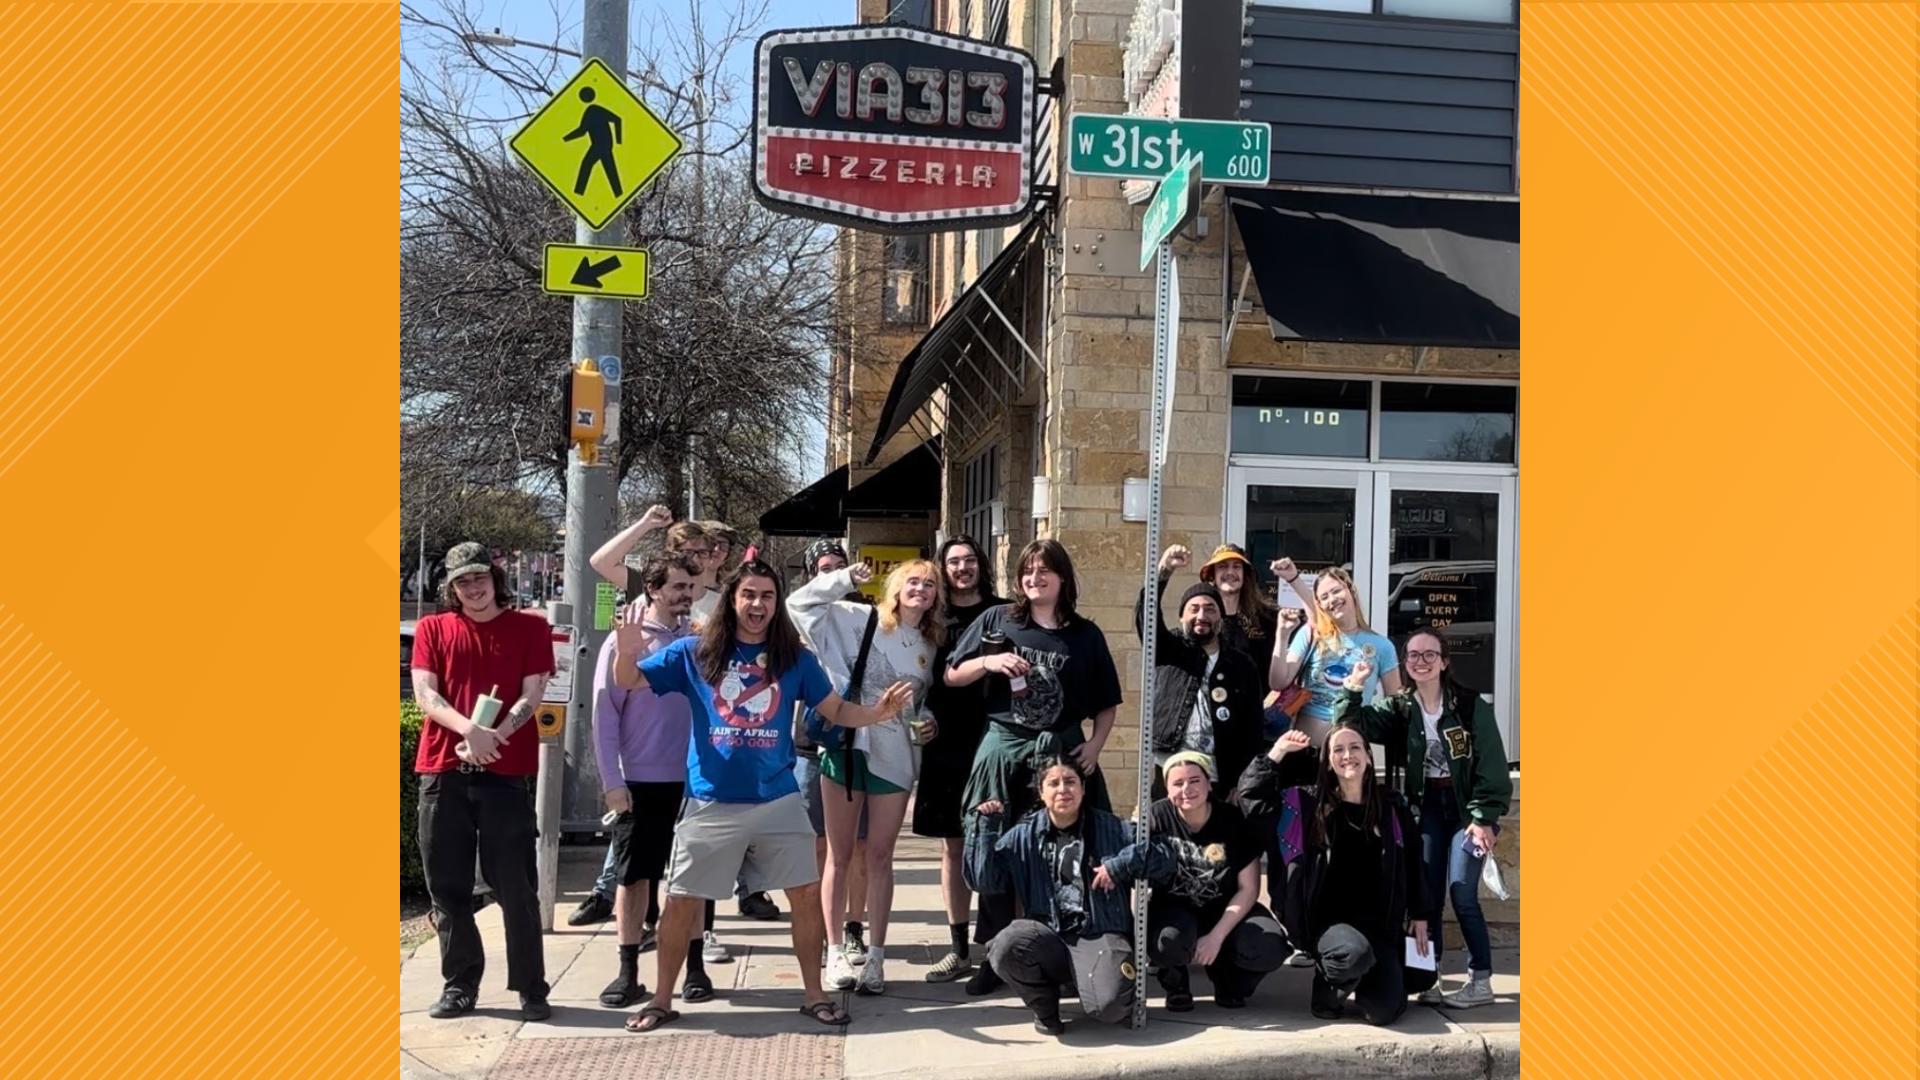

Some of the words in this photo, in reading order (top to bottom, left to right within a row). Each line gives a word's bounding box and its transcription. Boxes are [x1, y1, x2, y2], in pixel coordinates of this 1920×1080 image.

[1078, 132, 1095, 155] W
[1102, 123, 1183, 170] 31st
[1242, 128, 1263, 150] ST
[793, 153, 995, 188] PIZZERIA
[1227, 155, 1262, 177] 600
[1304, 410, 1340, 426] 100
[1428, 592, 1457, 603] OPEN
[1424, 605, 1459, 615] EVERY
[1431, 618, 1452, 628] DAY
[713, 726, 742, 737] AIN'T
[743, 728, 779, 738] AFRAID
[747, 737, 778, 748] GOAT
